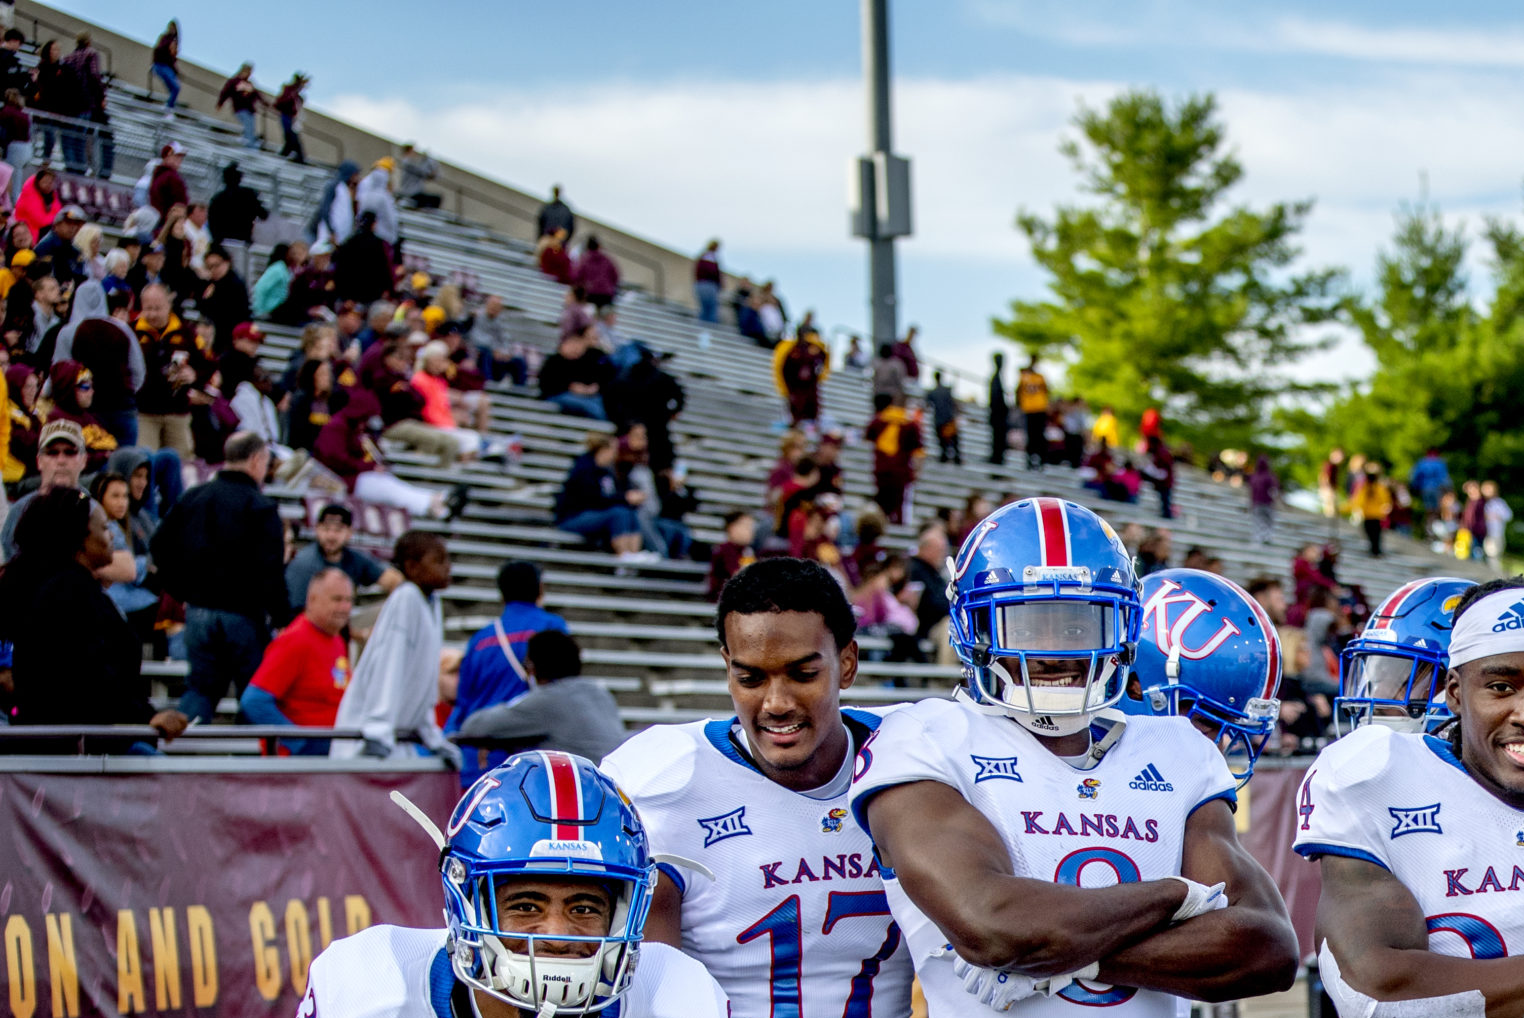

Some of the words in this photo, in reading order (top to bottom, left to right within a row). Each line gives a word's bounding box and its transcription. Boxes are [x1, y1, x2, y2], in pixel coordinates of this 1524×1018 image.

[1142, 579, 1240, 660] KU
[1031, 721, 1060, 731] adidas
[972, 758, 1018, 781] XII
[1128, 781, 1173, 792] adidas
[1299, 770, 1318, 831] 4
[699, 810, 750, 843] XII
[1020, 811, 1159, 844] KANSAS
[1391, 806, 1440, 836] XII
[548, 841, 588, 852] KANSAS
[760, 853, 884, 889] KANSA
[116, 903, 219, 1015] AND
